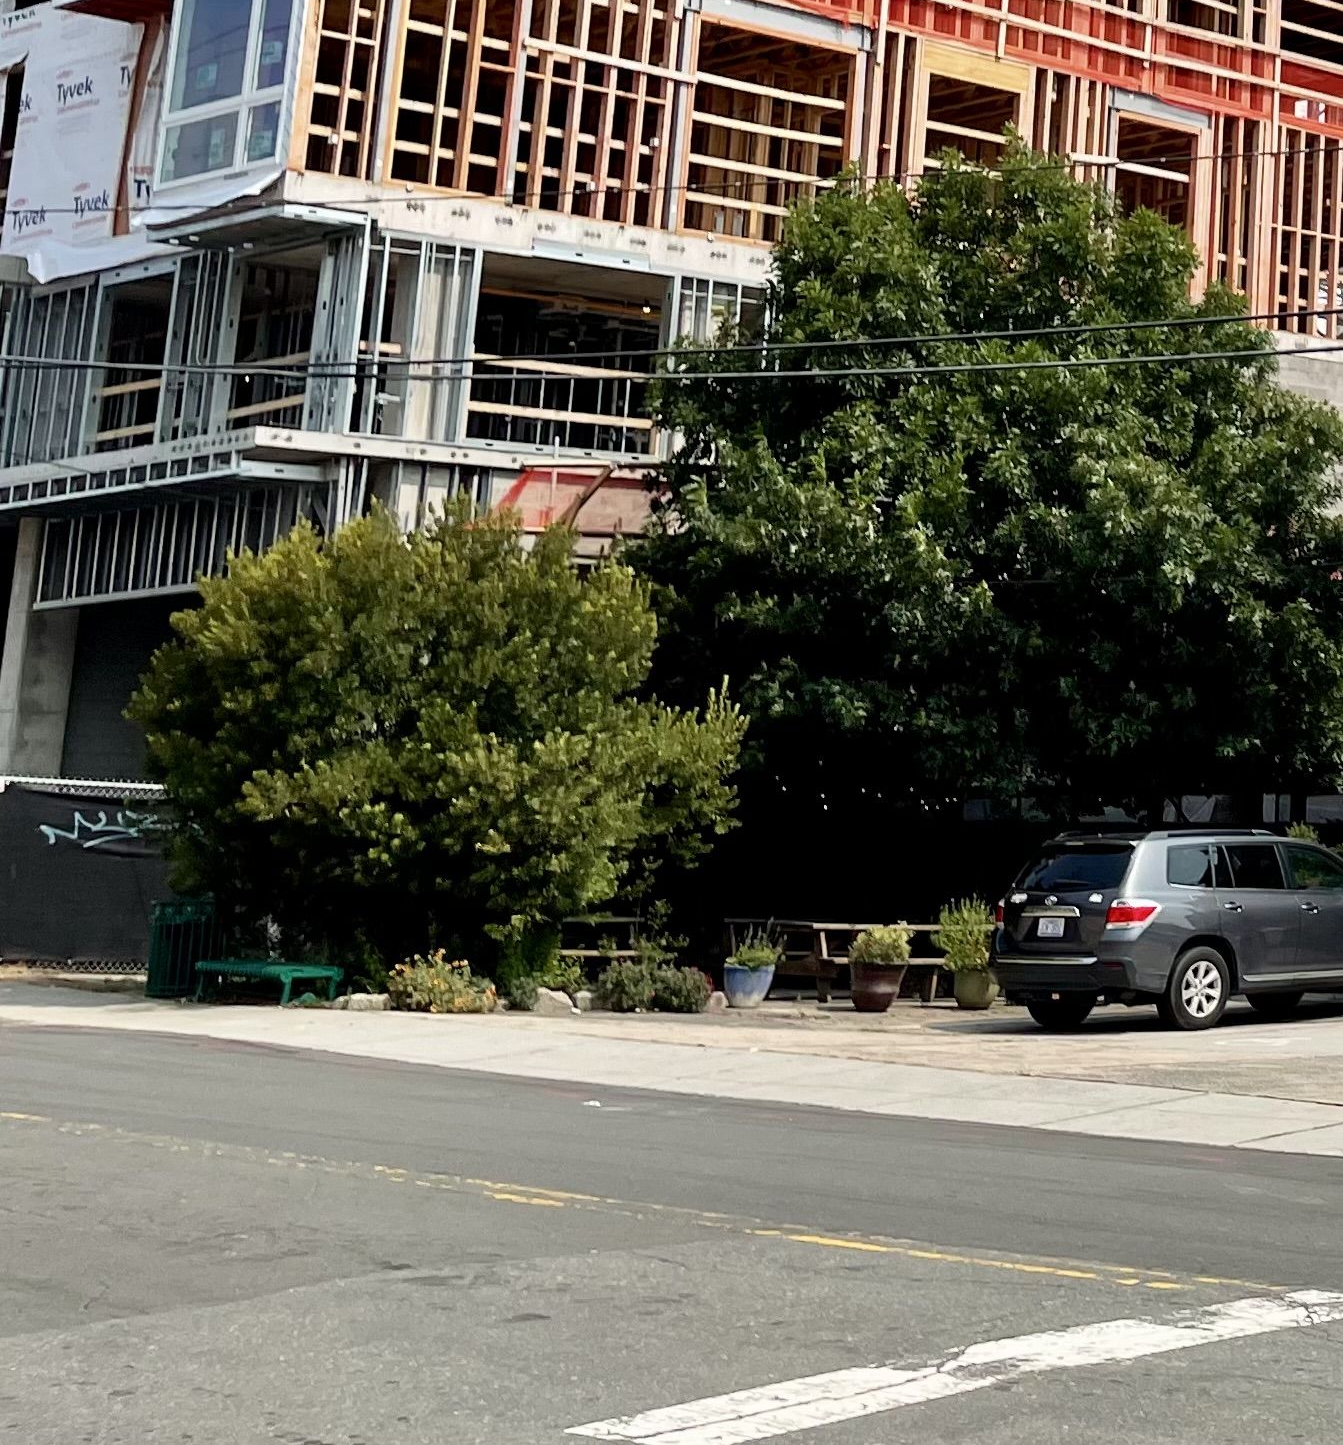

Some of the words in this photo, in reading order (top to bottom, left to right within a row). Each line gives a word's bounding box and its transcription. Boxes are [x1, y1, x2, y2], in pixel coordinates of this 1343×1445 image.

[57, 76, 93, 105] Tyvek
[12, 206, 46, 233] Tyvek
[74, 190, 109, 220] Tyvek
